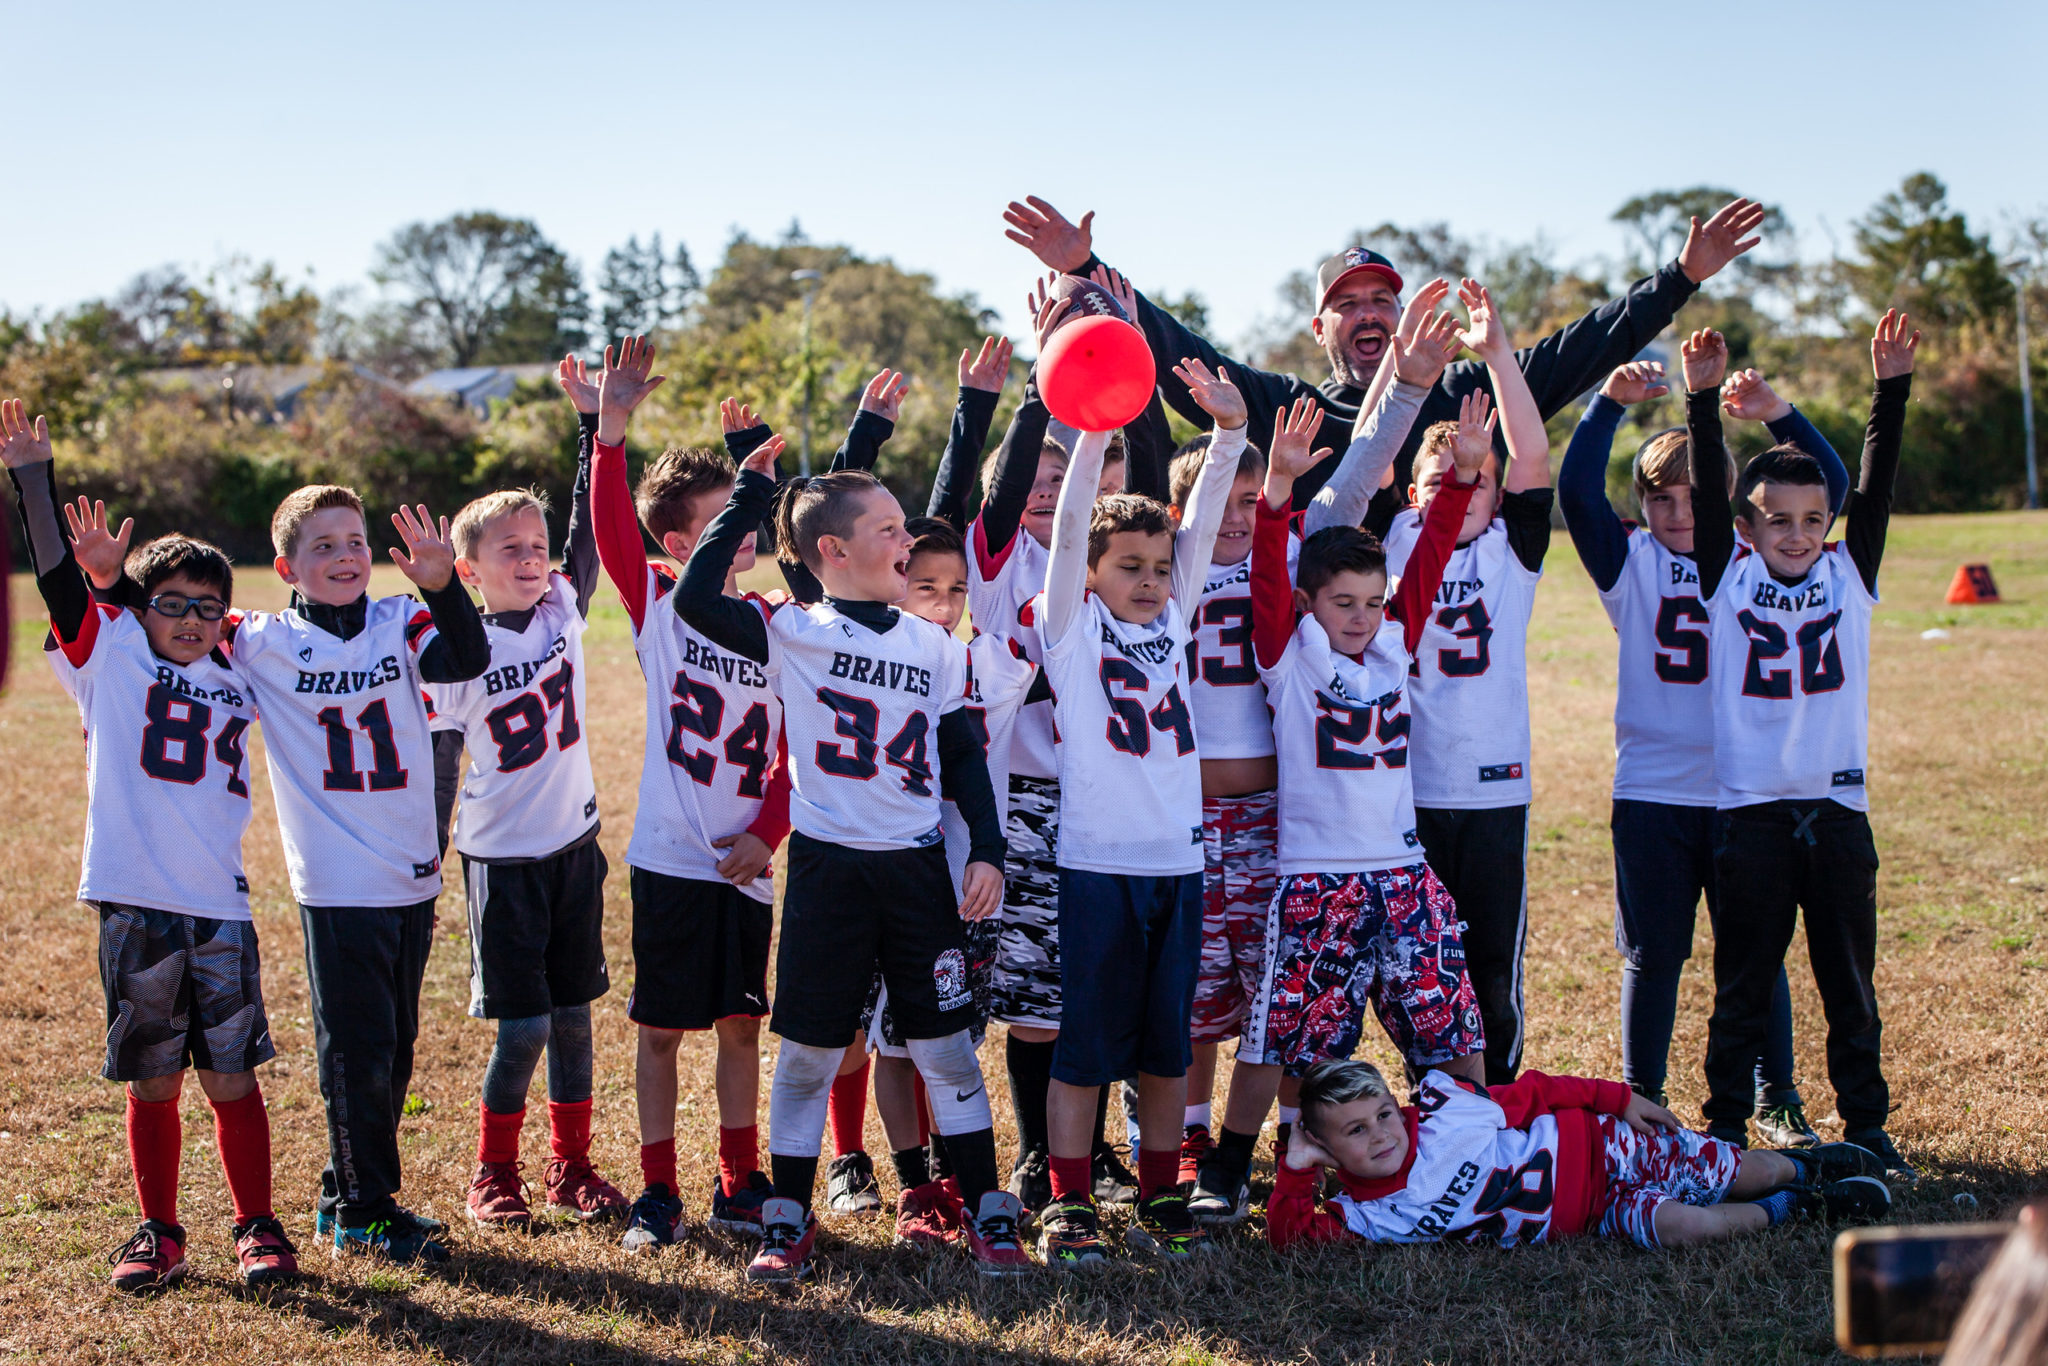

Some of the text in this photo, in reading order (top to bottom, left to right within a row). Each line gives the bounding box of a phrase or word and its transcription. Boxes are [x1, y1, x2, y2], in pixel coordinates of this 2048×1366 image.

[295, 655, 401, 694] BRAVES
[829, 651, 931, 697] BRAVES
[1736, 608, 1846, 700] 20
[140, 680, 250, 799] 84
[317, 697, 409, 792] 11
[484, 657, 581, 773] 87
[667, 669, 770, 800] 24
[815, 686, 934, 797] 34
[1313, 689, 1411, 770] 25
[1316, 961, 1349, 977] FLOW
[333, 1053, 348, 1122] UNDER
